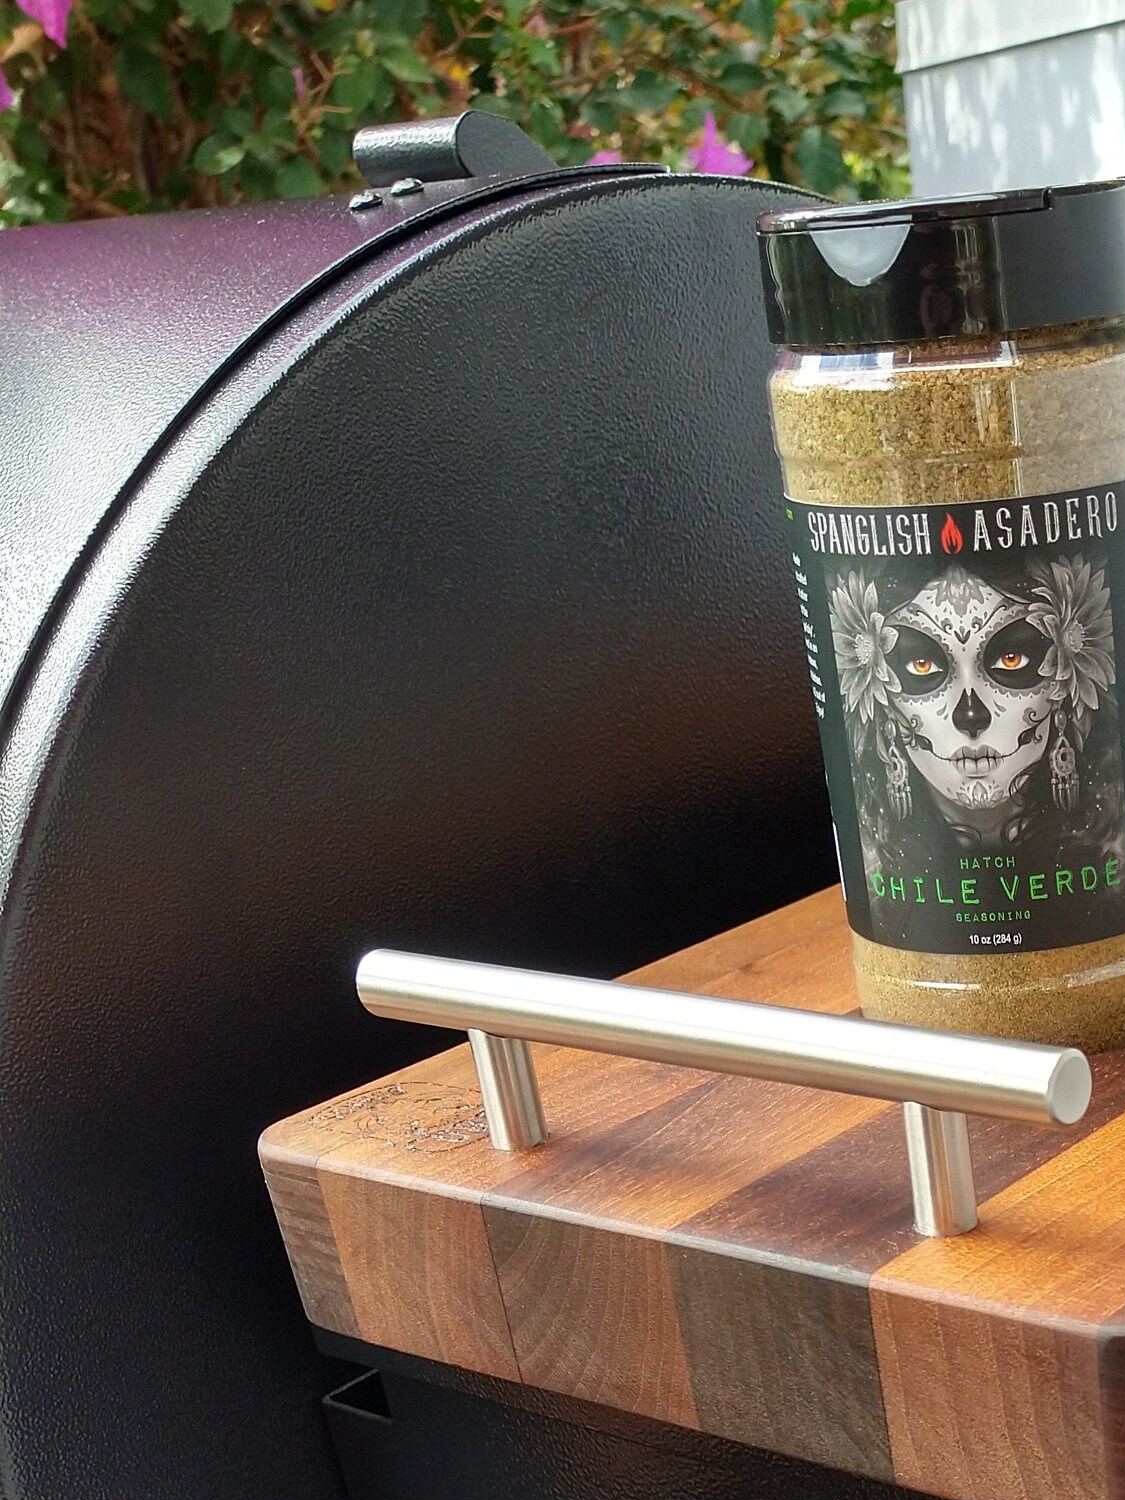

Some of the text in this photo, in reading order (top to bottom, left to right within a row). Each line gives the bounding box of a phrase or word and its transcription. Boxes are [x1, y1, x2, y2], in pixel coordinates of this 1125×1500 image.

[807, 491, 1118, 557] SPANGLISH ASADERO
[960, 856, 1016, 870] HATCH
[871, 872, 980, 905] CHILE
[1000, 859, 1121, 901] VERDE
[955, 910, 1031, 923] SEASONING
[969, 932, 1022, 946] 10 oz (284 g)
